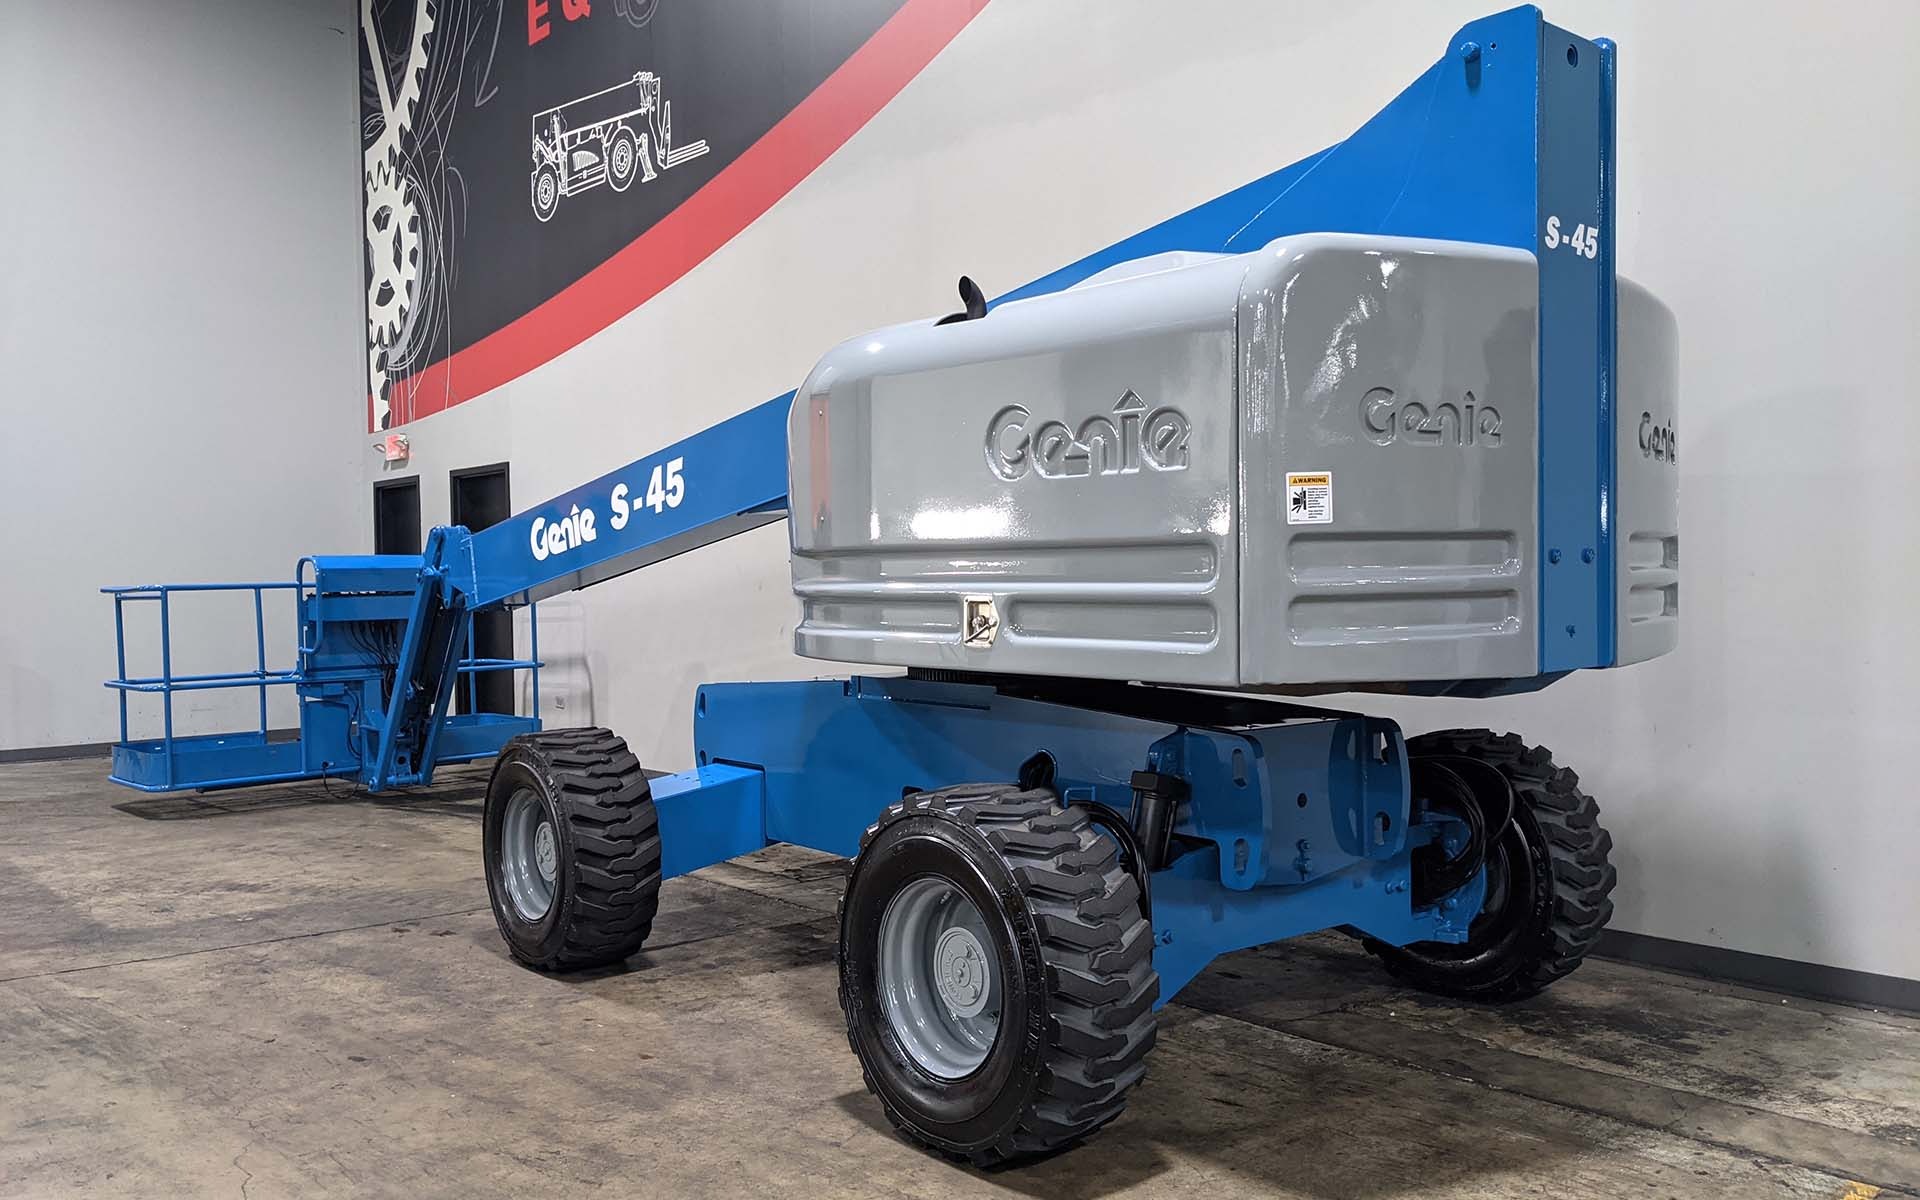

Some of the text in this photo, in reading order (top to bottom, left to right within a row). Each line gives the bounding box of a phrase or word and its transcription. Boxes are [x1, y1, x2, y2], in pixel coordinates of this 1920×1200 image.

[1545, 216, 1599, 259] S-45
[984, 388, 1191, 482] Genie
[1358, 386, 1503, 448] Genie
[530, 456, 685, 561] Genie S-45
